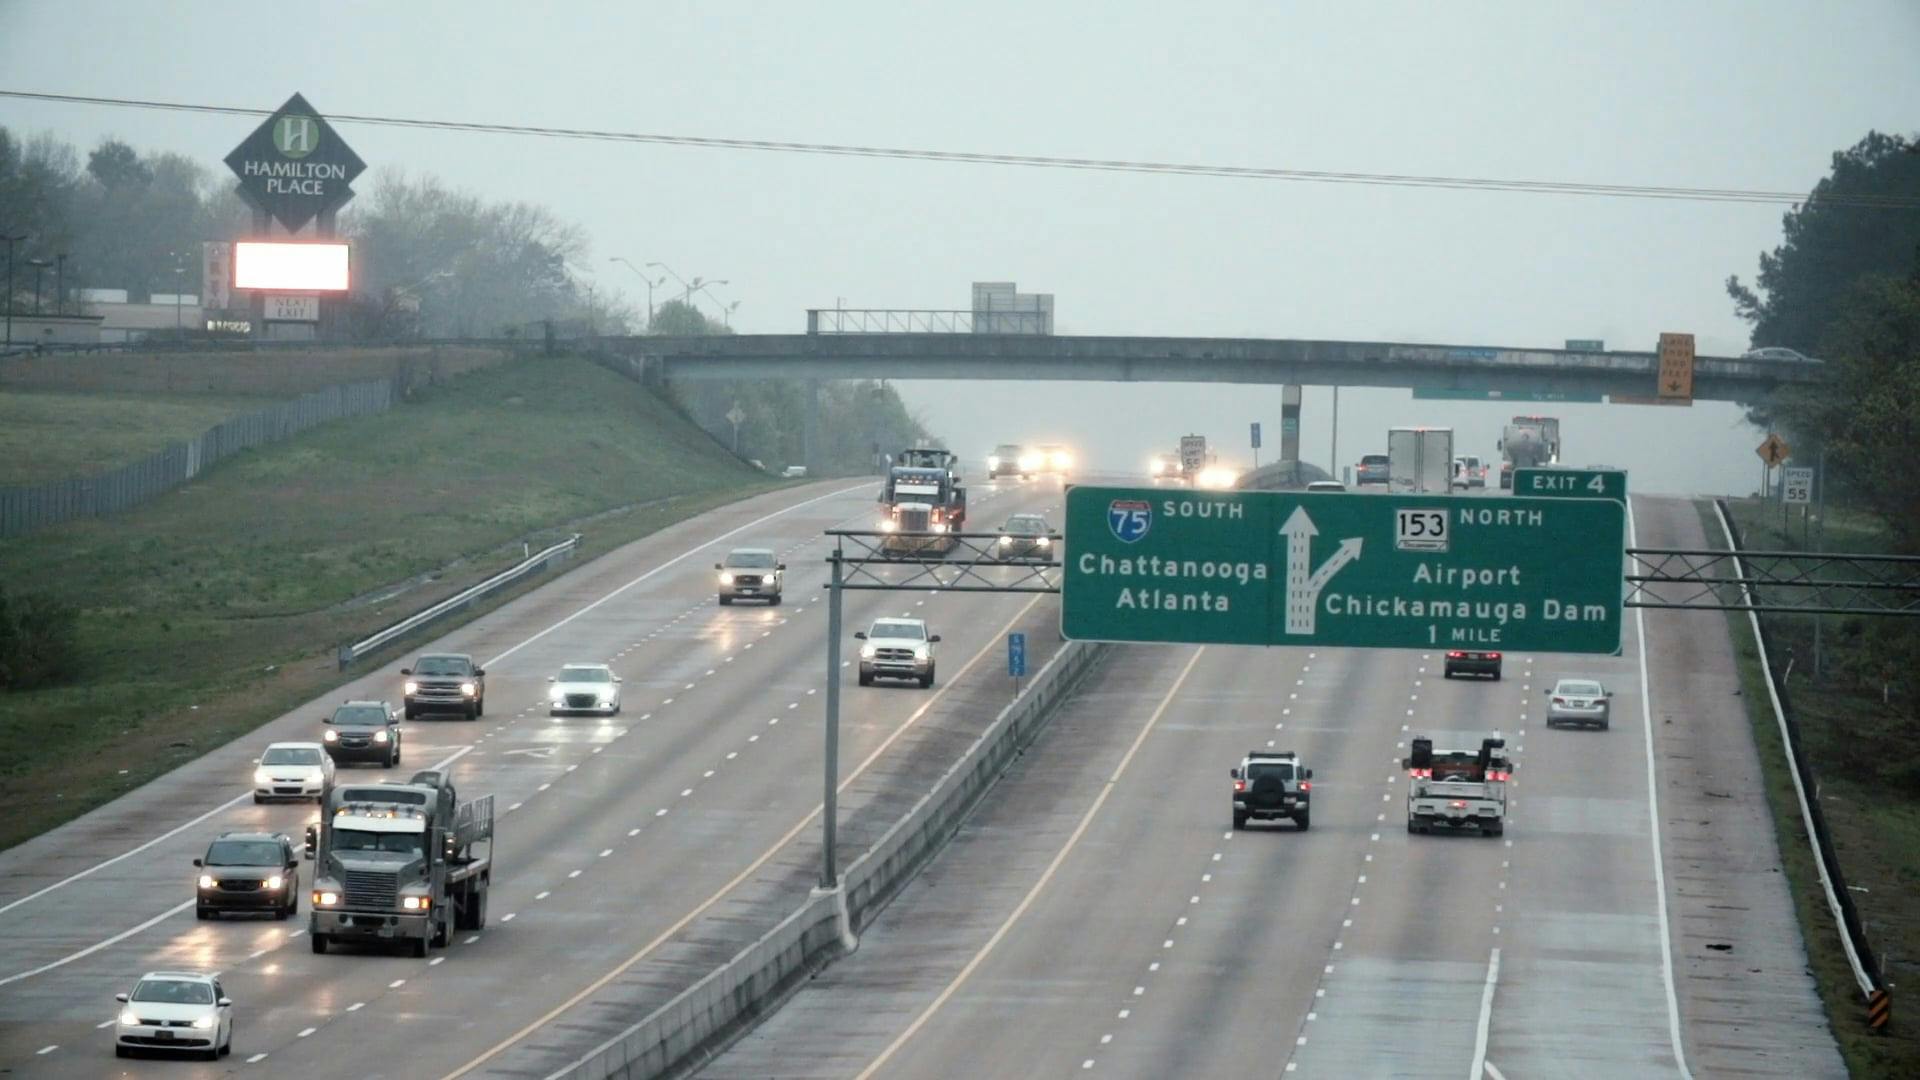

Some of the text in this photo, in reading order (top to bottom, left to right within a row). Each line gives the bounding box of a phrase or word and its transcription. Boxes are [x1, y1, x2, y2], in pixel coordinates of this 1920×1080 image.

[244, 160, 346, 180] HAMILTON
[266, 178, 324, 196] PLACE
[278, 307, 305, 317] EXIT
[1533, 475, 1606, 493] EXIT 4
[1786, 470, 1811, 478] SPEED
[1787, 488, 1808, 500] 55
[1112, 501, 1243, 534] 75 SOUTH
[1399, 509, 1543, 537] 153 NORTH
[1079, 552, 1267, 583] Chattanooga
[1413, 563, 1520, 590] Airport
[1116, 589, 1229, 612] Atlanta
[1325, 594, 1606, 625] Chickamauga Dam
[1427, 625, 1502, 645] 1 MILE
